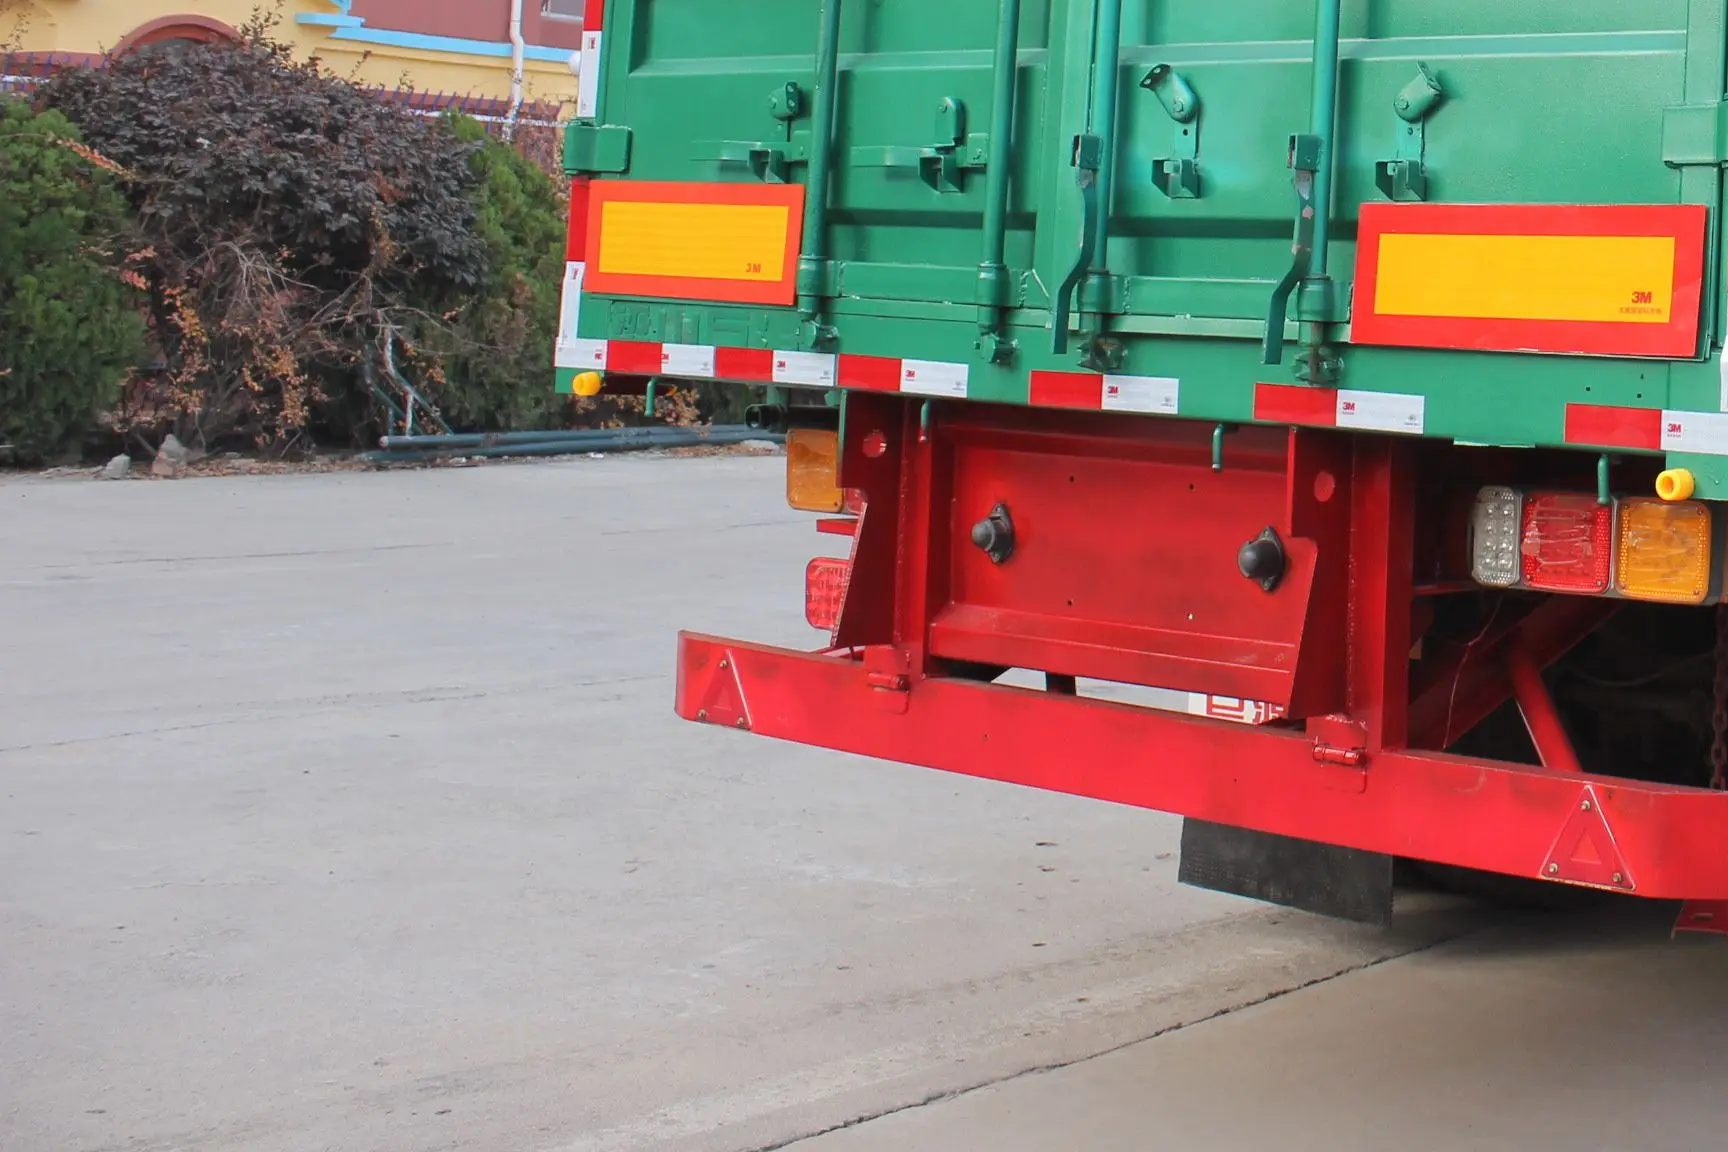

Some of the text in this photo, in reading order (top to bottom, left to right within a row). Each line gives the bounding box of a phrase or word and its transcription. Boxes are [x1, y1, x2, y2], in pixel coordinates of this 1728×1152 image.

[1631, 291, 1652, 304] 3M
[905, 369, 915, 378] 3M
[1108, 385, 1118, 394] 3M
[1342, 402, 1355, 411] 3M
[1668, 424, 1681, 433] 3M
